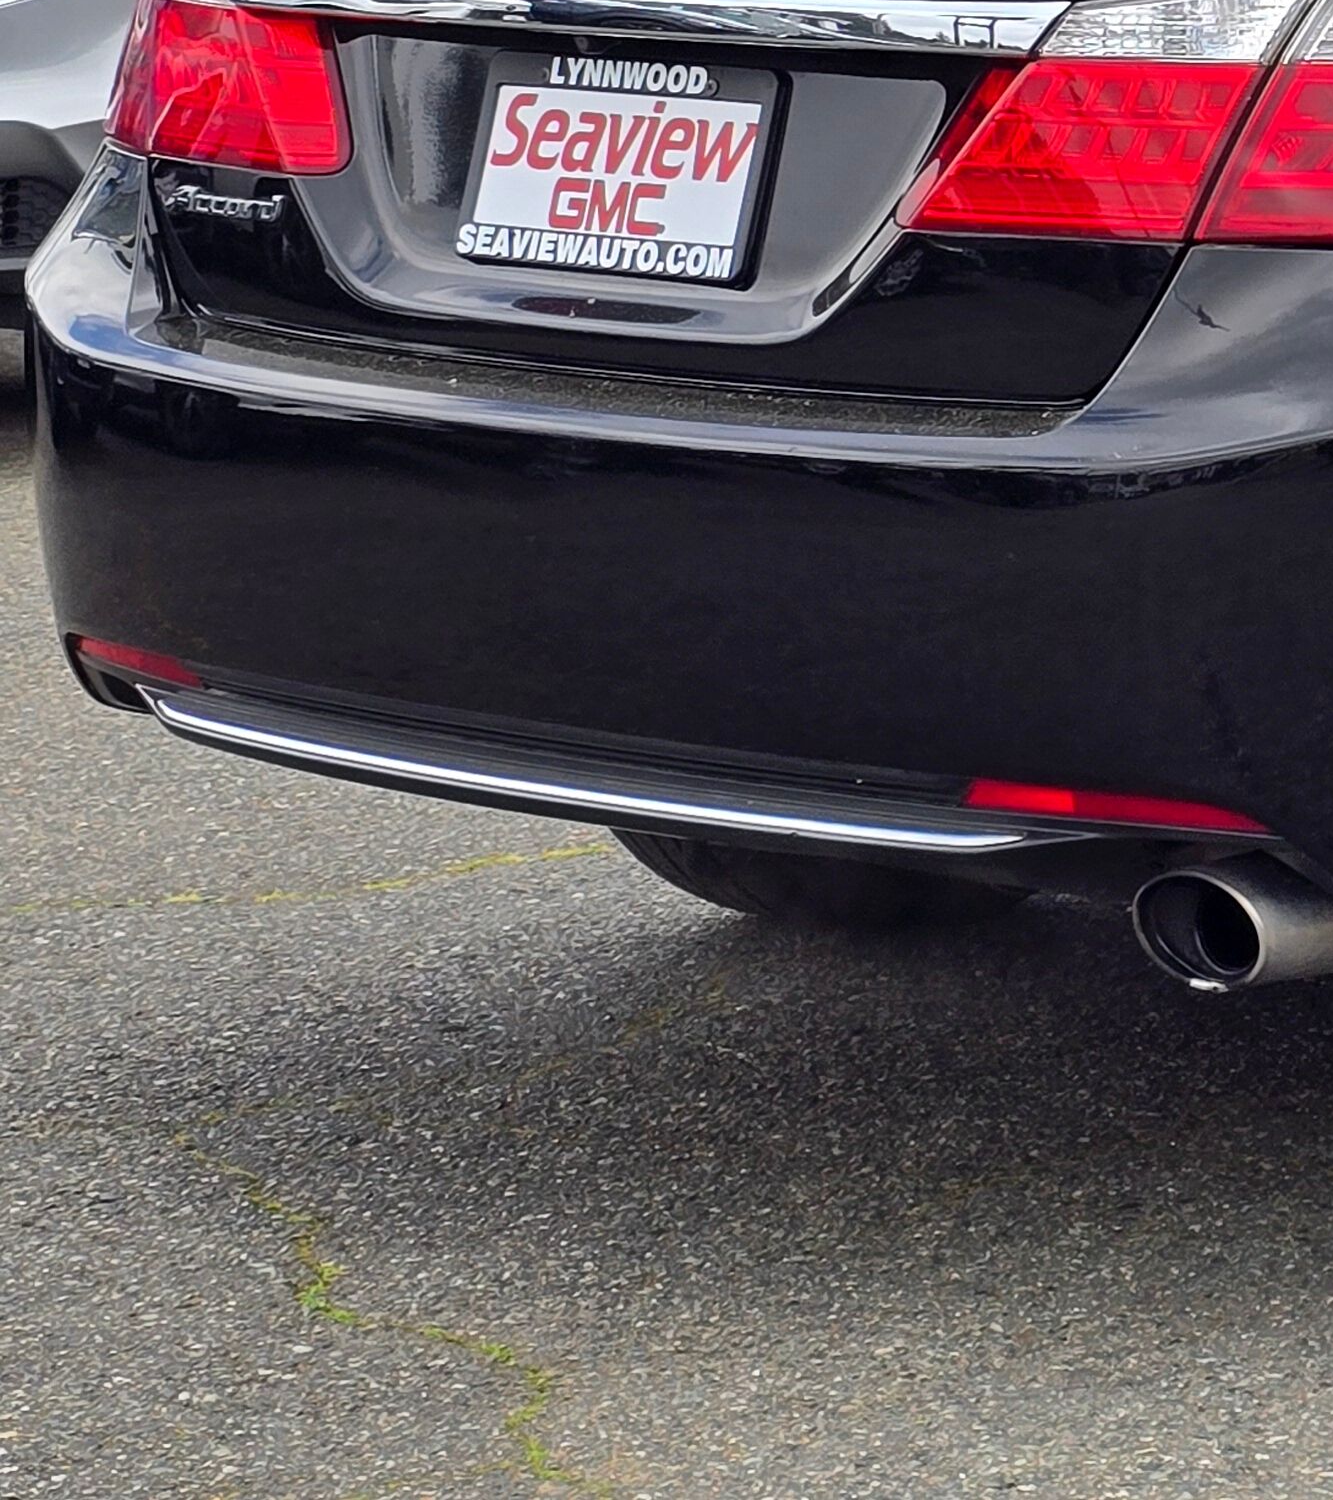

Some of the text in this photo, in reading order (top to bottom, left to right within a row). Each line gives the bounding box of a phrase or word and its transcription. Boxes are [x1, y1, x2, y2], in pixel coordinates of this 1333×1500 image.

[550, 57, 708, 94] LYNNWOOD
[490, 93, 761, 182] Seaview
[165, 185, 284, 222] Accord
[548, 176, 667, 236] GMC
[456, 223, 734, 279] SEAVIEWAUTO.COM
